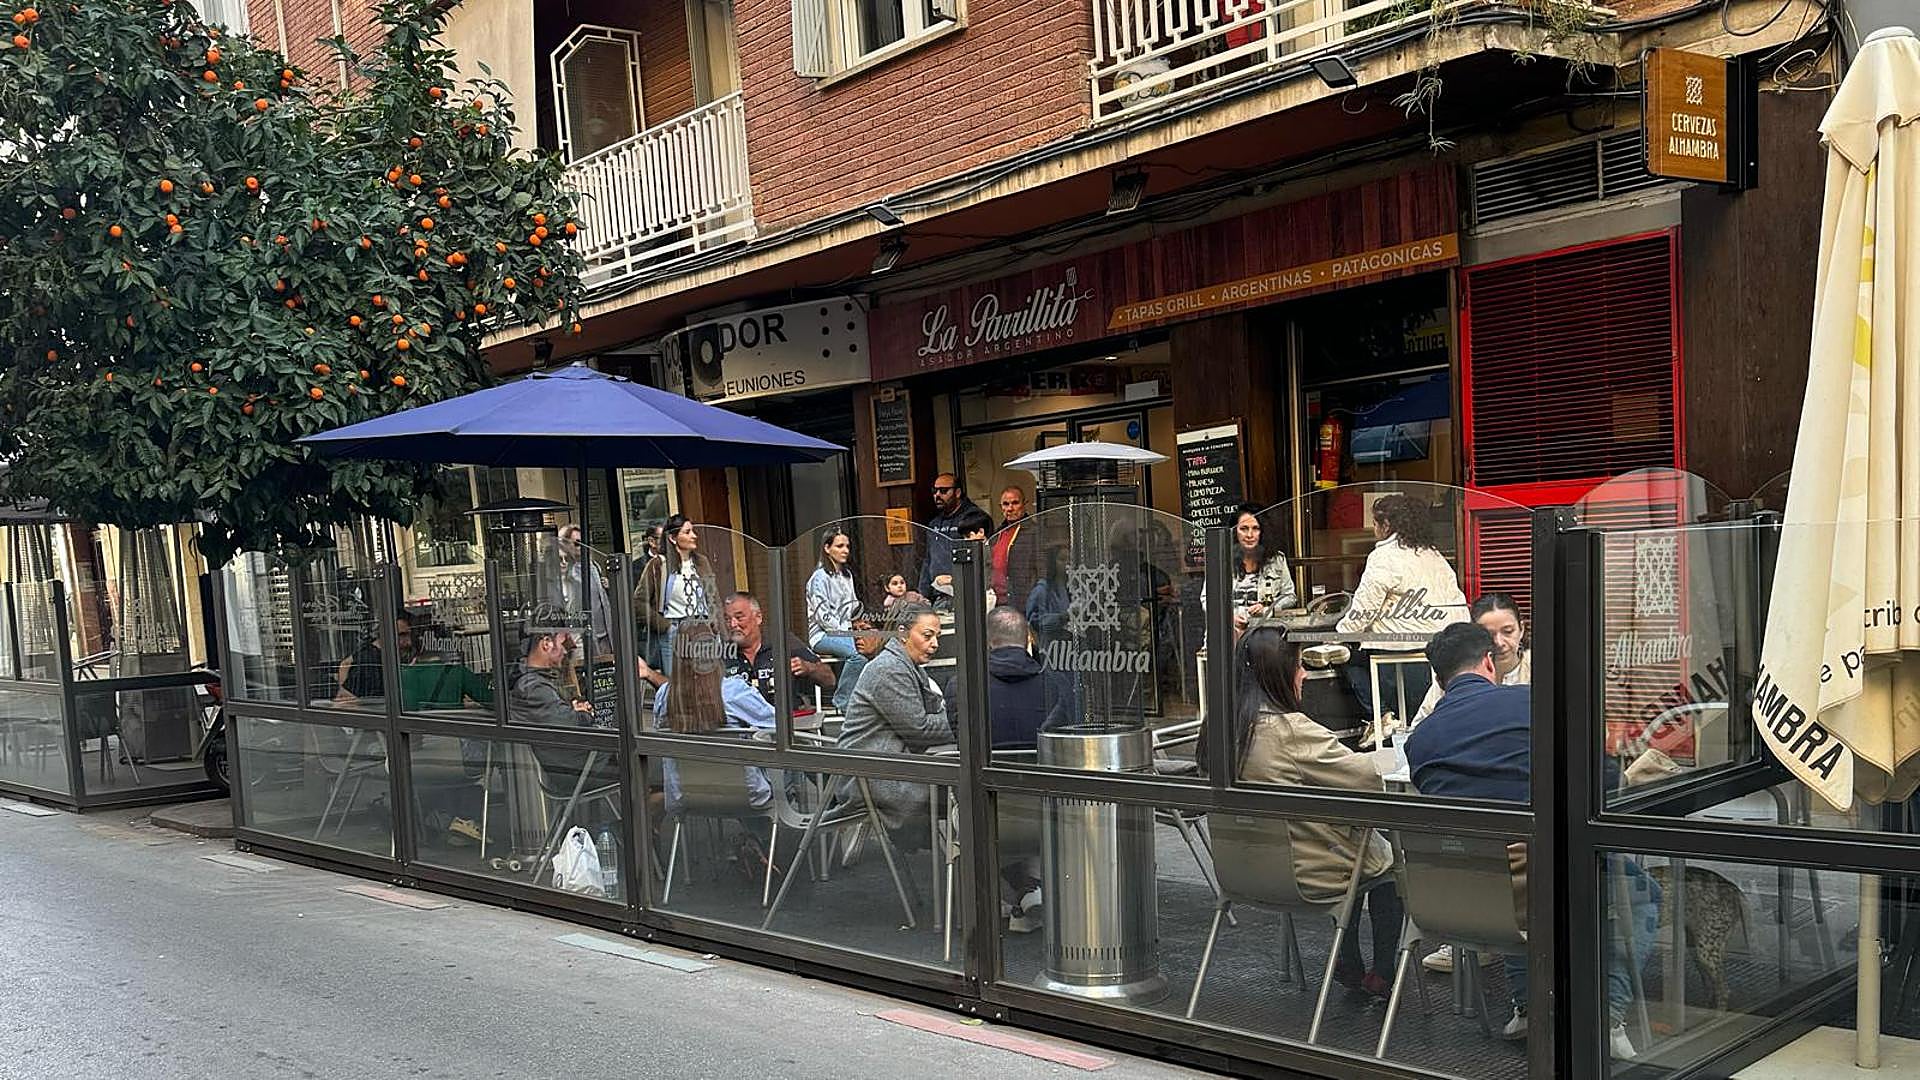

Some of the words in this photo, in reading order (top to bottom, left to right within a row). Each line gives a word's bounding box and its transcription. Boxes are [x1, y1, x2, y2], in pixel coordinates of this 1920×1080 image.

[1672, 112, 1717, 137] CERVEZAS
[1668, 136, 1720, 160] ALHAMBRA
[1124, 302, 1163, 321] TAPAS
[1167, 293, 1204, 313] GRILL
[1221, 270, 1312, 302] ARGENTINAS
[1332, 241, 1443, 278] PATAGONICAS
[918, 305, 959, 356] La
[965, 282, 1079, 347] Parrillita
[984, 330, 1074, 355] ARGENTINO
[725, 370, 806, 396] EUNIONES
[1039, 639, 1150, 673] Alhambra
[1607, 627, 1693, 668] Alhambra
[1755, 663, 1844, 782] AMBRA
